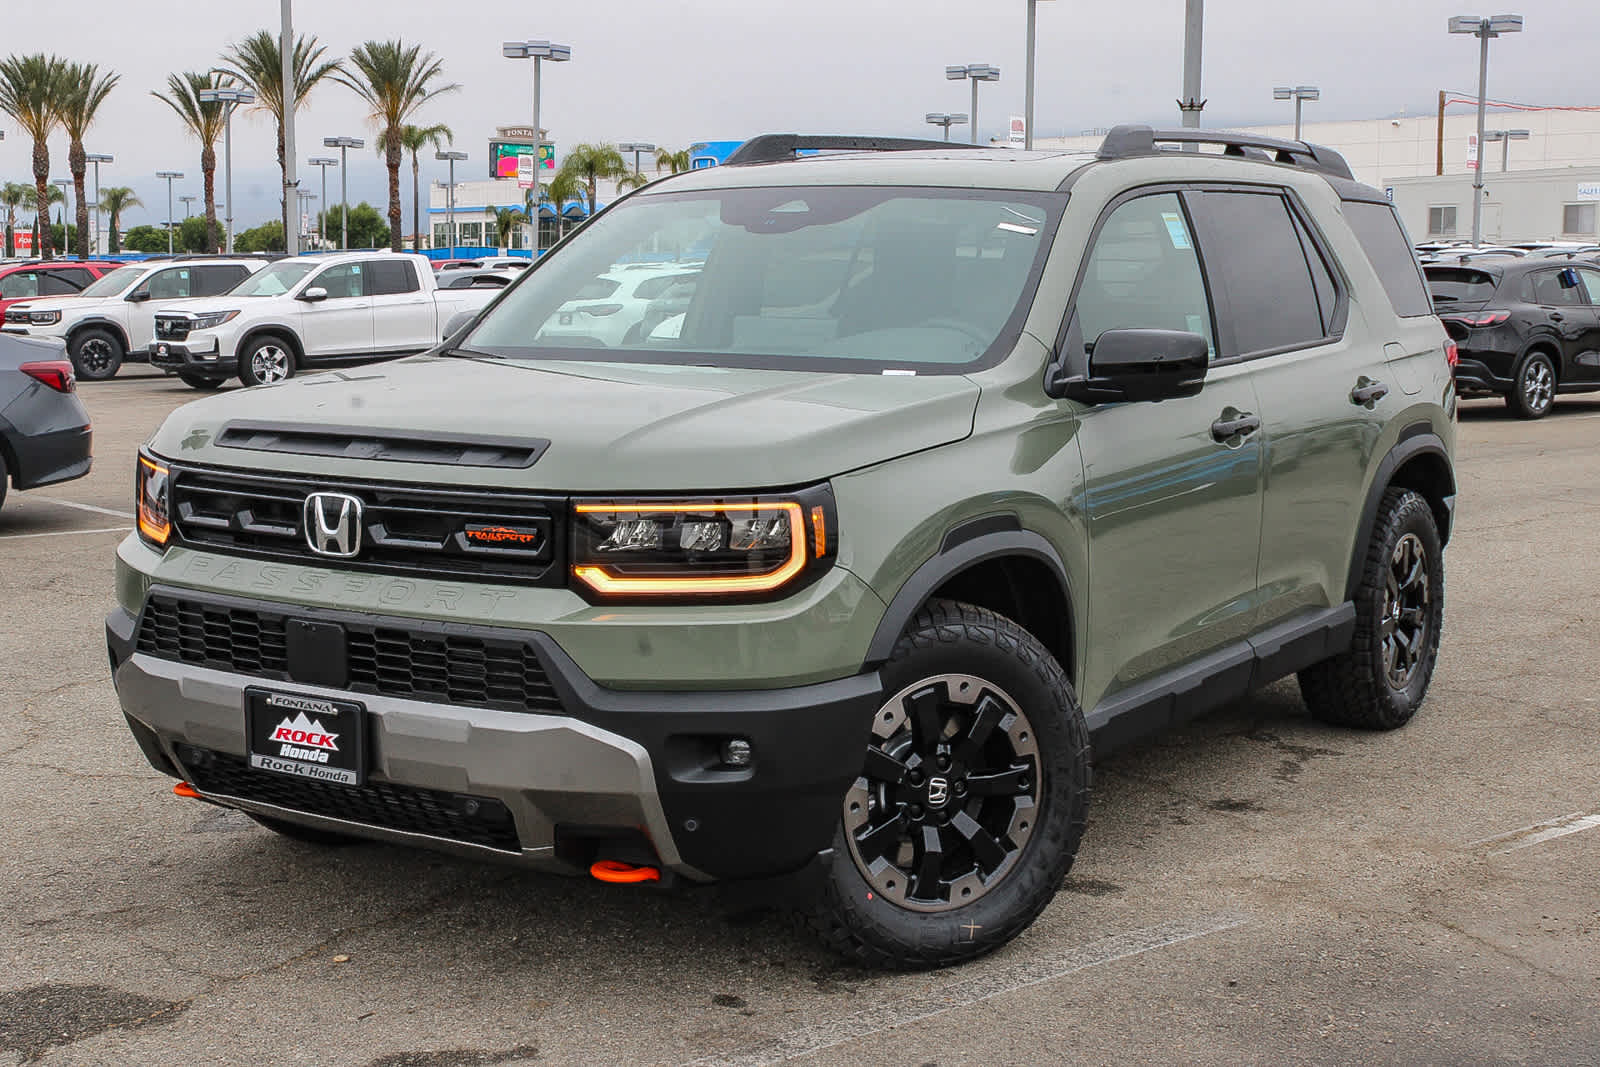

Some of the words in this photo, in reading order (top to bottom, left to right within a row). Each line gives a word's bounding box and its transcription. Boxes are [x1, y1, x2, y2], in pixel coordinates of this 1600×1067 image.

[466, 530, 535, 543] TRAILSPORT
[184, 555, 517, 615] PASSPORT
[275, 697, 331, 713] FONTANA
[275, 728, 336, 748] ROCK
[280, 744, 329, 763] Honda
[260, 757, 305, 775] Rock
[309, 767, 349, 782] Honda
